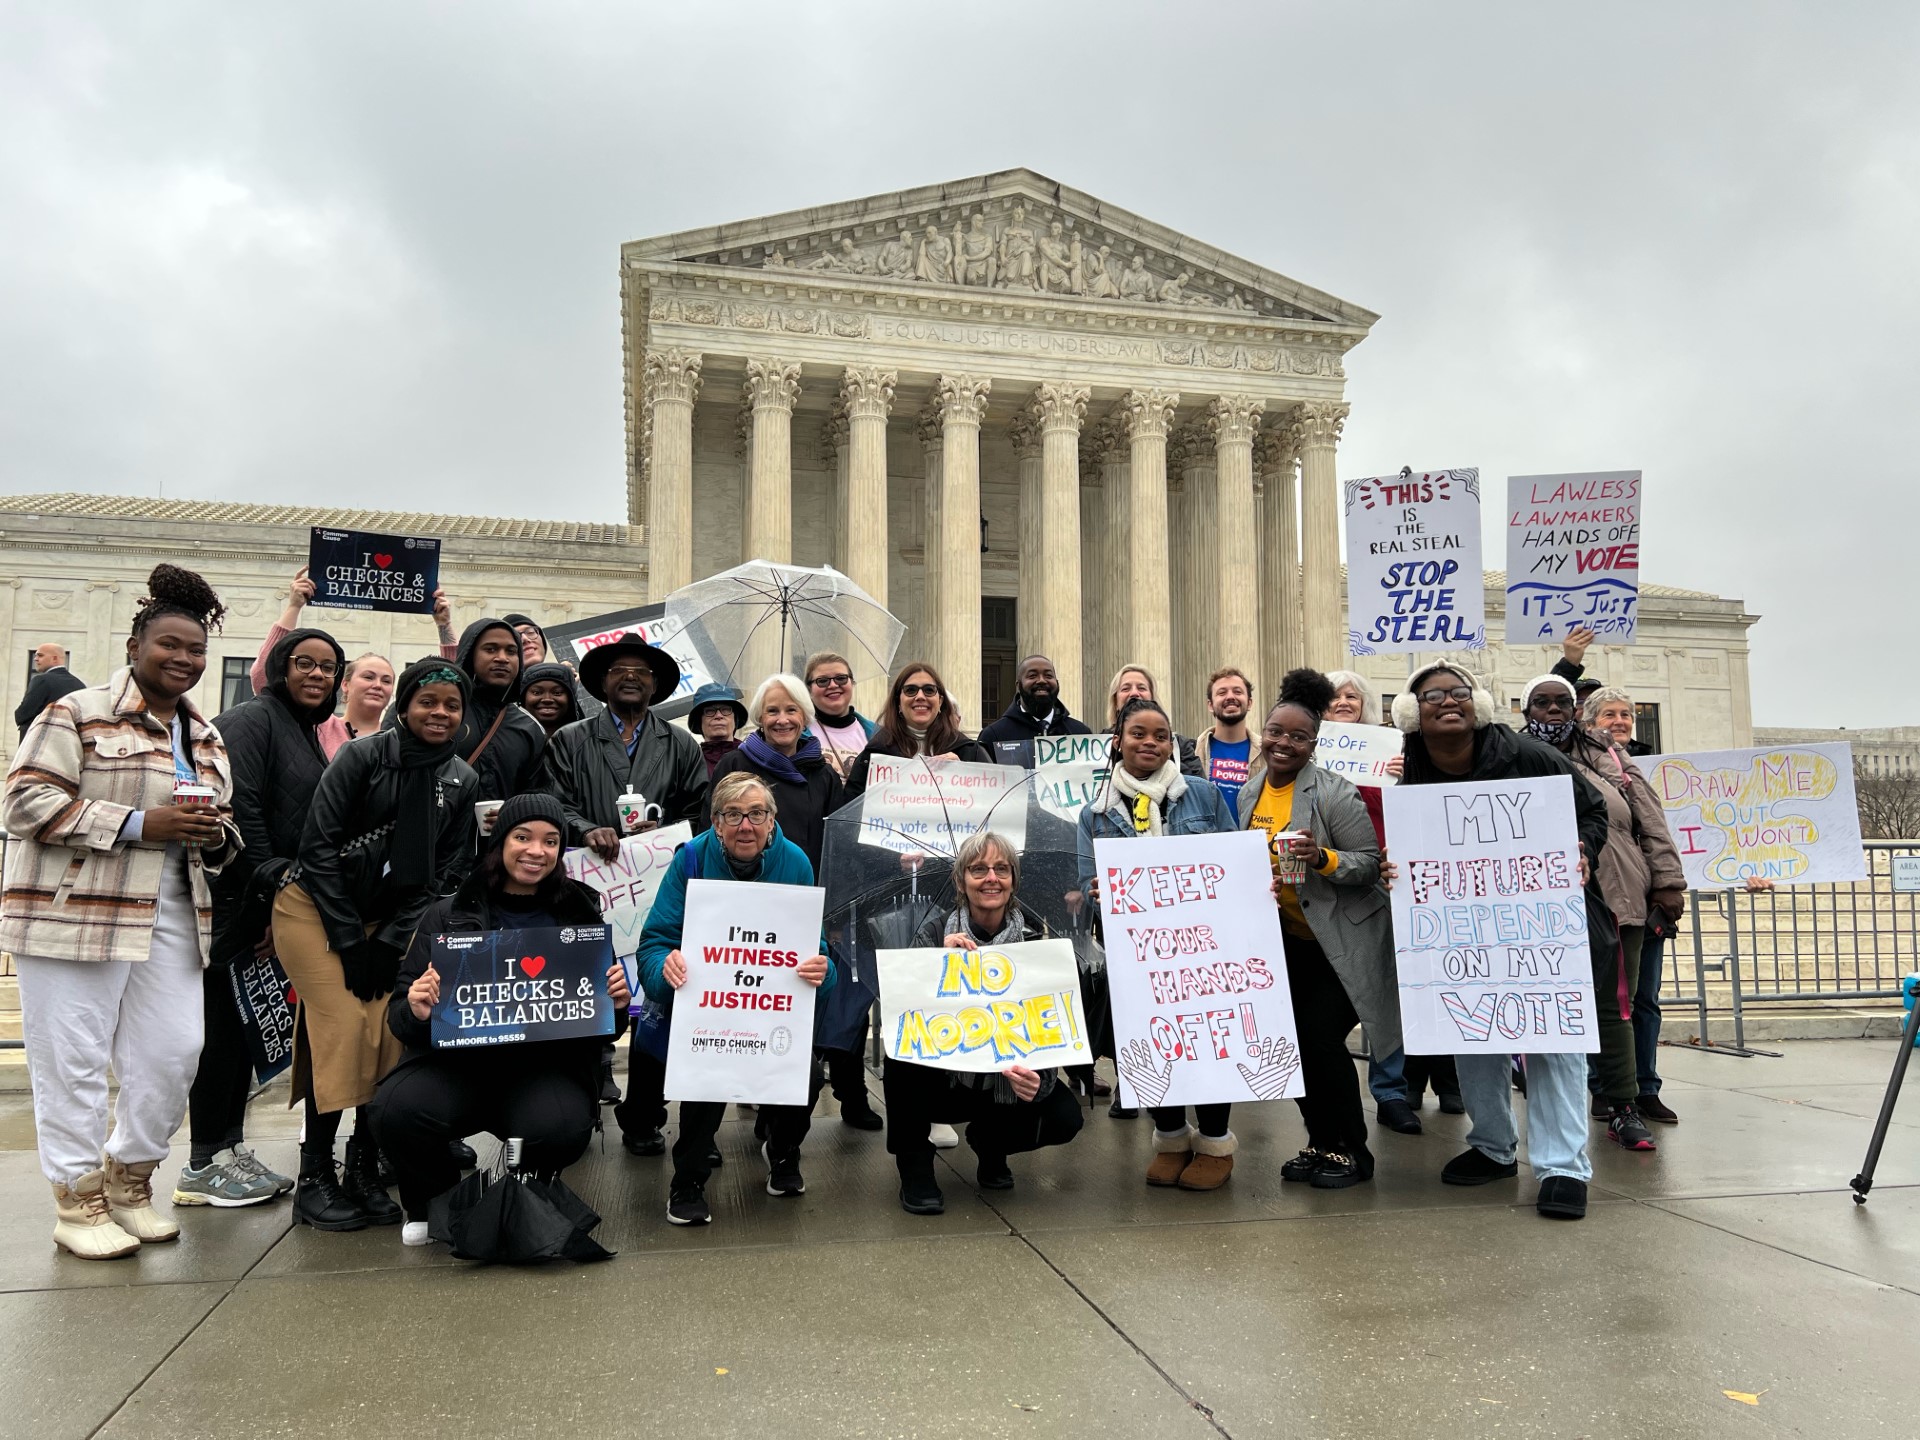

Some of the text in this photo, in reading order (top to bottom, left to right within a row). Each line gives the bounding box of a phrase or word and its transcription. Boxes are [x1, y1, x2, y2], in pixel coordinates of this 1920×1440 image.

[884, 322, 1143, 357] EQUAL JUSTICE UNDER LAW
[1380, 482, 1433, 506] THIS
[1531, 479, 1639, 504] LAWLESS
[1403, 507, 1417, 522] IS
[1510, 505, 1636, 526] LAWMAKERS
[1394, 522, 1426, 535] THE
[1522, 523, 1639, 549] HANDS OFF
[1370, 534, 1466, 555] REAL STEAL
[362, 552, 372, 568] I
[1530, 543, 1638, 574] MY VOTE
[326, 565, 425, 587] CHECKS &
[1380, 559, 1459, 589] STOP
[326, 581, 425, 603] BALANCES
[1387, 588, 1456, 614] THE
[1522, 593, 1574, 617] IT'S
[1367, 614, 1475, 643] STEAL
[1537, 616, 1637, 638] A THEORY
[1338, 735, 1368, 751] OFF
[1662, 755, 1812, 801] DRAW ME
[901, 820, 928, 834] vote
[1443, 791, 1532, 846] MY
[1714, 802, 1768, 827] OUT
[1678, 825, 1809, 855] I WON'T
[1408, 851, 1570, 904] FUTURE
[1715, 857, 1799, 882] COUNT
[1899, 862, 1919, 870] AREA
[1107, 863, 1226, 915] KEEP
[1410, 895, 1588, 947] DEPENDS
[447, 935, 483, 944] Common
[447, 942, 472, 950] Cause
[728, 926, 777, 944] I'm a
[1127, 925, 1218, 962] YOUR
[504, 958, 516, 980] I
[703, 946, 799, 968] WITNESS
[1443, 947, 1565, 981] ON MY
[734, 970, 764, 987] for
[936, 950, 1017, 998] NO
[1149, 957, 1275, 1004] HANDS
[456, 977, 595, 1006] CHECKS &
[699, 990, 793, 1012] JUSTICE!
[242, 962, 284, 1063] BALANCES
[458, 999, 595, 1029] BALANCES
[1440, 992, 1585, 1041] VOTE
[894, 990, 1084, 1064] MOORE!
[1149, 1002, 1262, 1062] OFF!
[437, 1033, 526, 1048] Text MOORE to 95559
[692, 1037, 767, 1049] UNITED CHURCH
[716, 1047, 766, 1056] CHRIST
[208, 1174, 228, 1188] N
